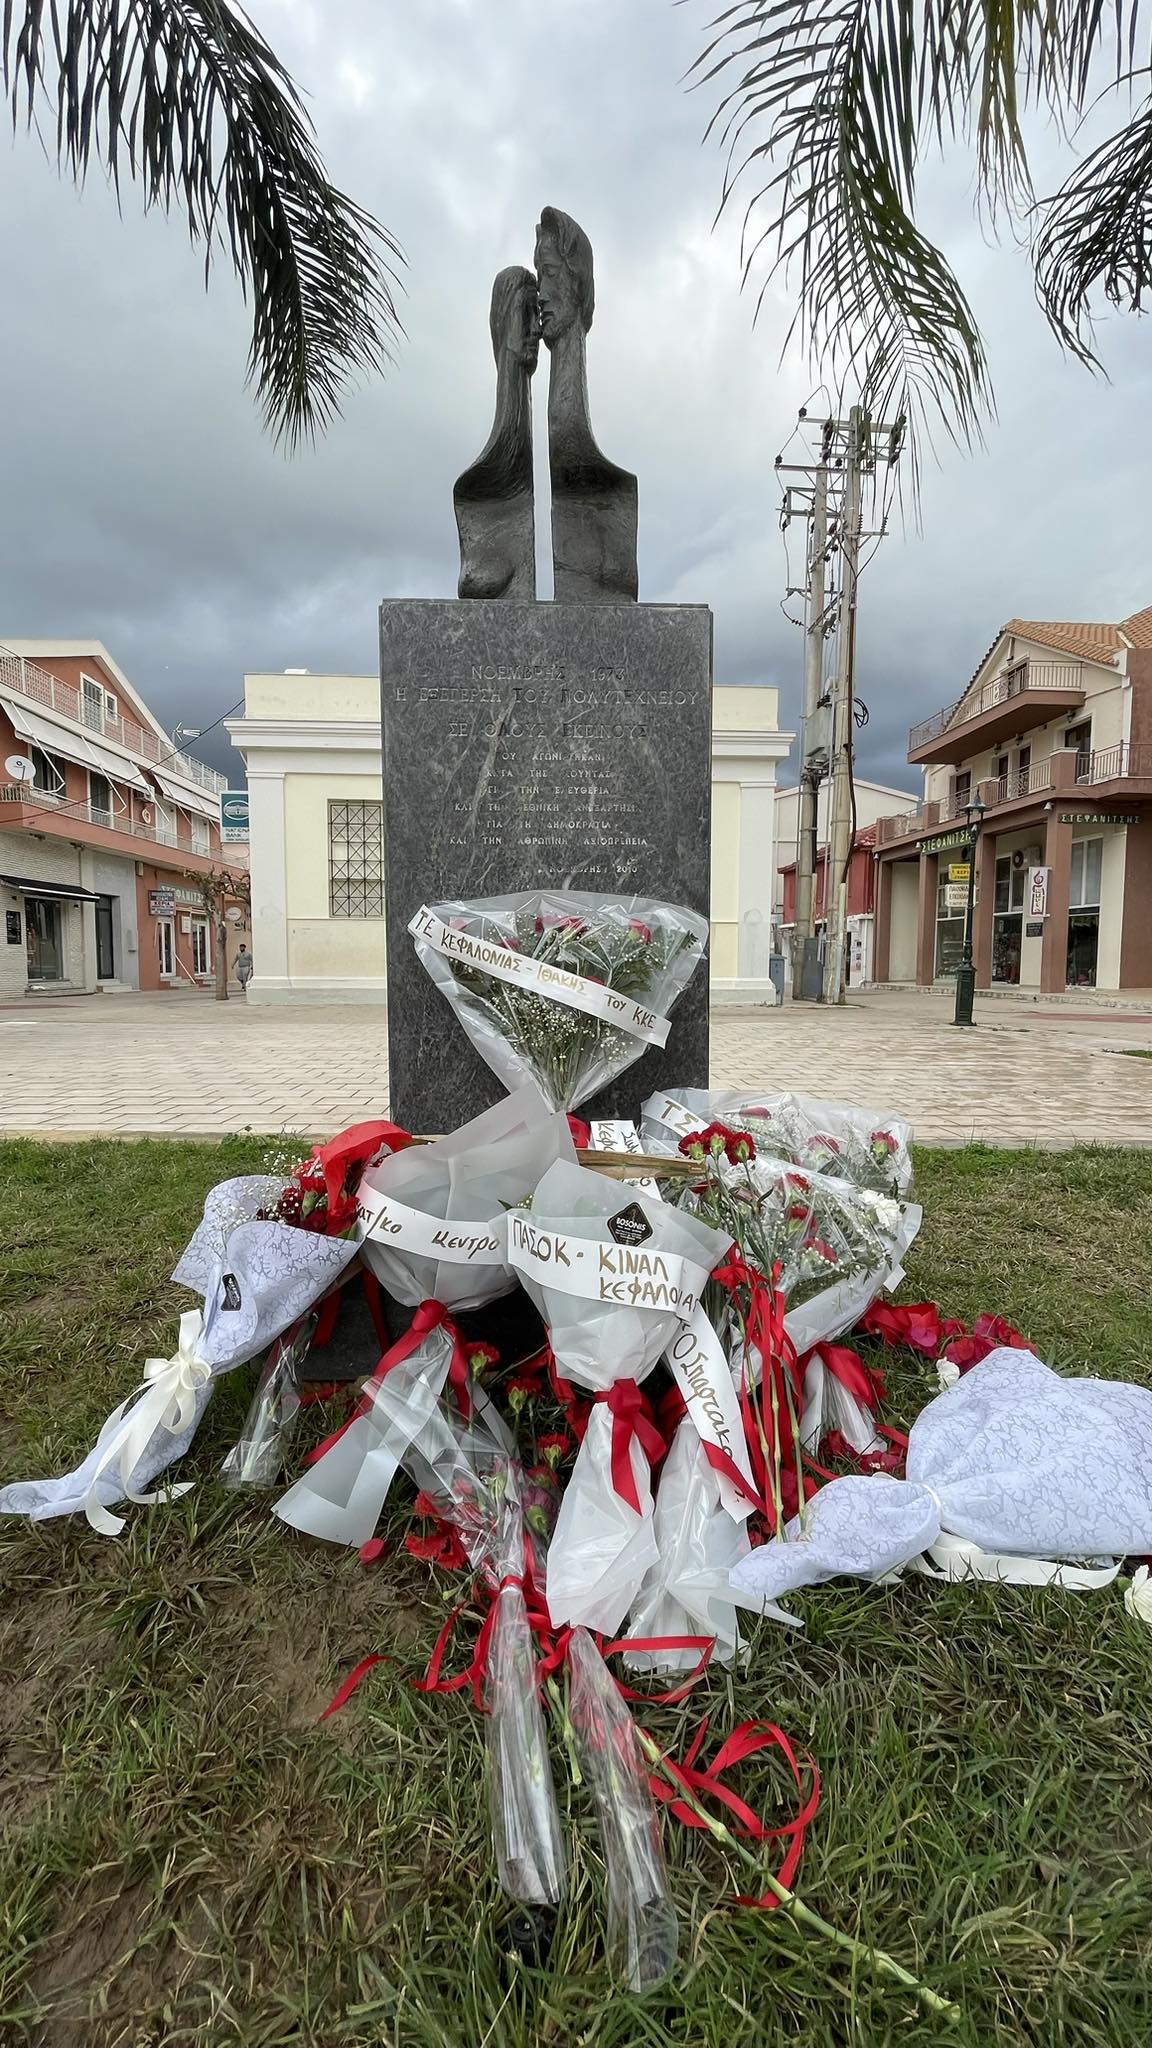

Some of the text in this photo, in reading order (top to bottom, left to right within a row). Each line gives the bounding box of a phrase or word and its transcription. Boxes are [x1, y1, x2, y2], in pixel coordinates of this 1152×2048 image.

[471, 664, 626, 682] ΝΟΕΜΒΡΗΣ 1973
[395, 687, 700, 705] Η ΕΞΕΓΕΡΣΗ ΤΟΥ ΠΟΛΥΤΕΧΝΕΙΟΥ
[448, 722, 649, 740] ΣΕ ΟΛΟΥΣ ΕΚΕΙΝΟΥΣ
[532, 752, 603, 761] ΑΓΩΝΙΗΚΑΝ
[486, 769, 611, 778] ΚΤΑ ΤΗΣ ΟΥΝΤΑΣ
[520, 786, 540, 794] ΤΗΝ
[1061, 814, 1140, 824] ΣΤΕΦΑΝΙΤΣΗΣ
[483, 837, 502, 845] ΤΗΝ
